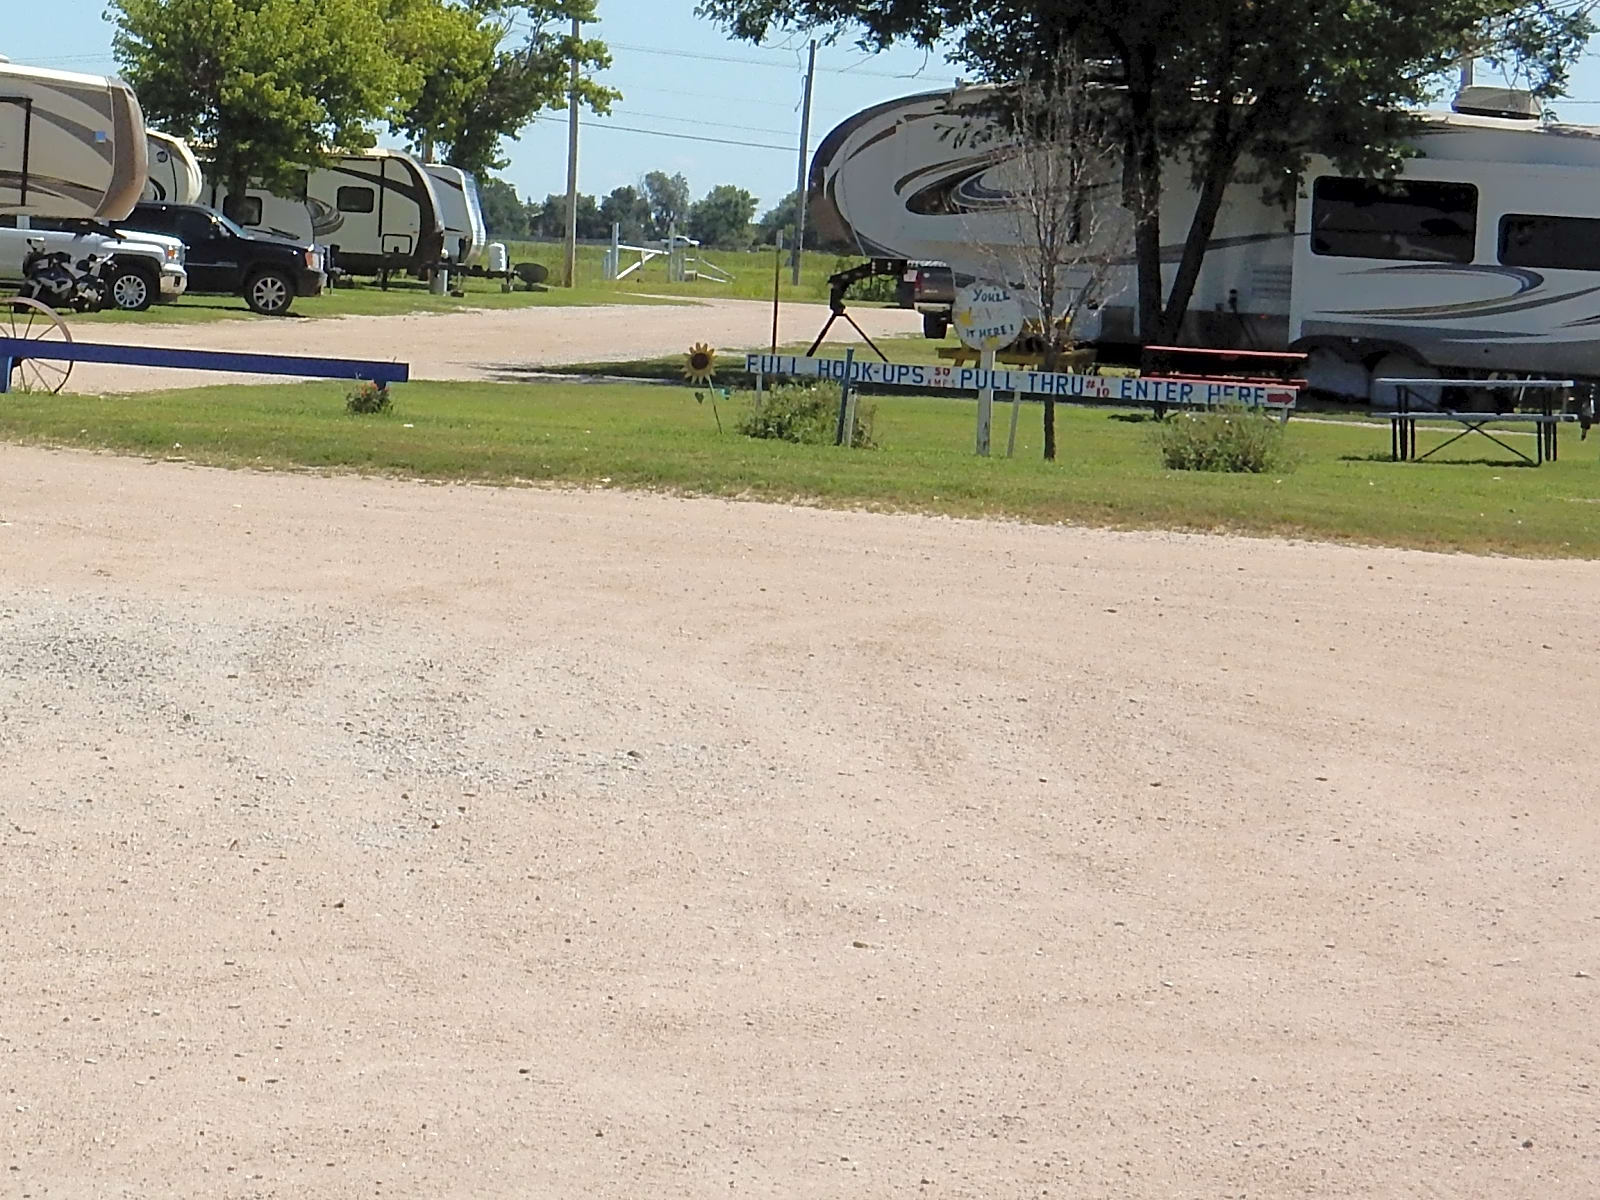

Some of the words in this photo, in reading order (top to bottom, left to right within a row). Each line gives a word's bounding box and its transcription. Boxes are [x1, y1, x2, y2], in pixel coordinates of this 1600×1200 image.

[747, 354, 800, 375] FULL
[817, 358, 925, 384] HOOK-UPS
[960, 368, 1016, 391] PULL
[1028, 372, 1084, 397] THRU
[1121, 379, 1193, 403] ENTER
